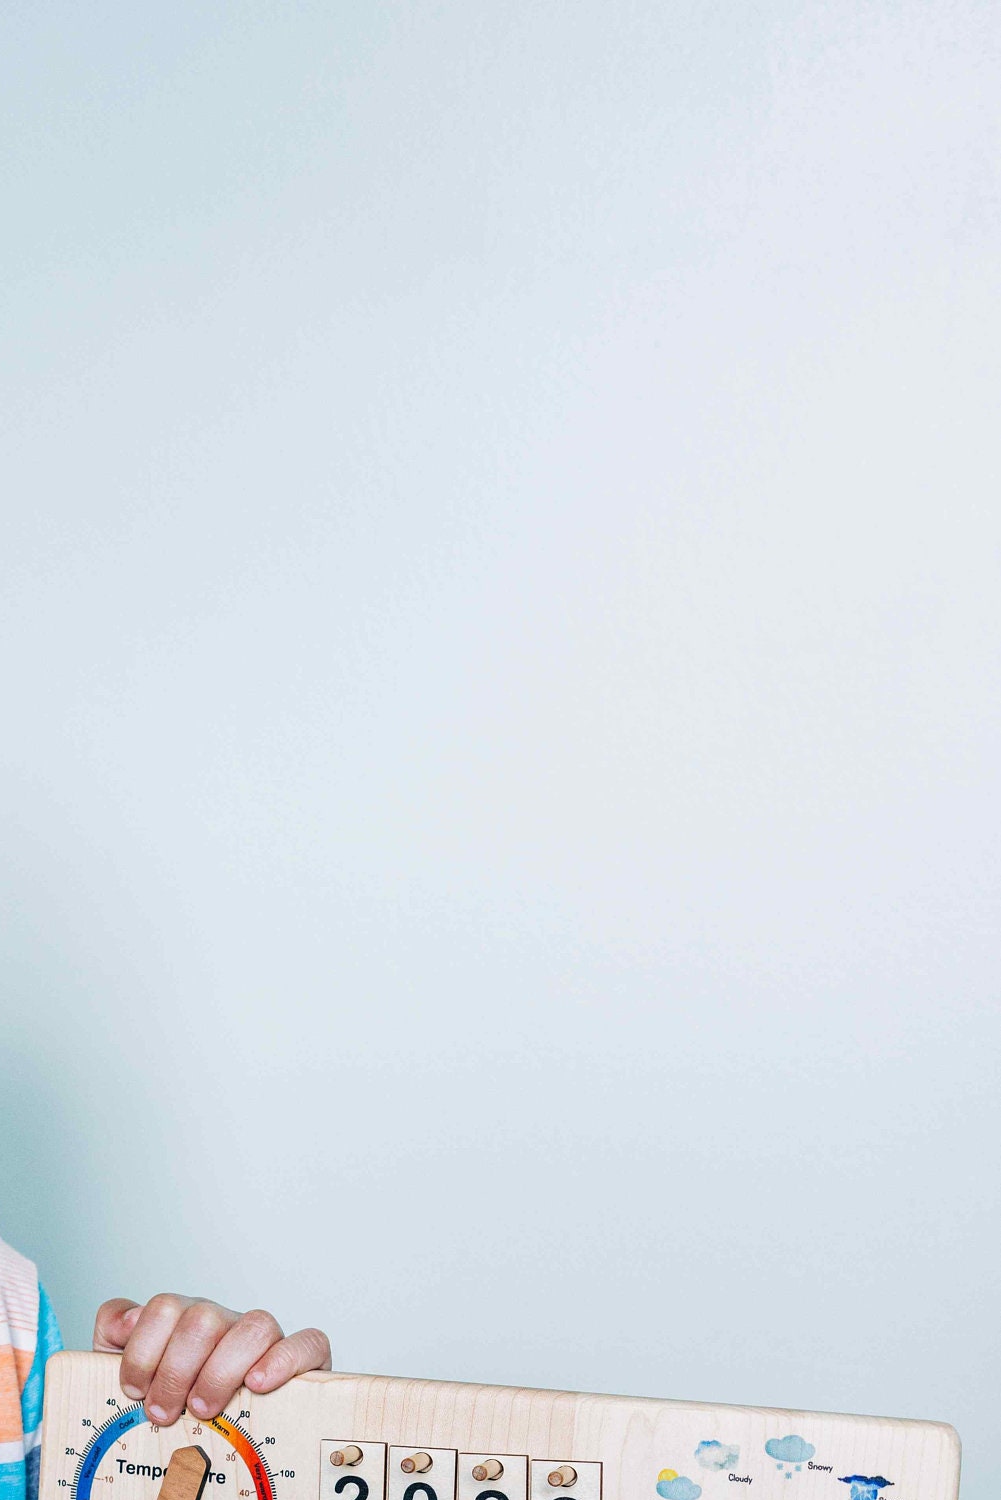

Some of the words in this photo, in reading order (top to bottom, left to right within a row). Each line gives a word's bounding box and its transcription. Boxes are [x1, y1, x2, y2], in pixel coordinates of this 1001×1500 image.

[240, 1410, 250, 1418] 80
[82, 1419, 92, 1427] 30
[119, 1417, 135, 1429] Cold
[192, 1427, 202, 1435] 20
[211, 1418, 230, 1437] Warm
[265, 1437, 276, 1445] 90
[226, 1453, 236, 1462] 30
[807, 1461, 833, 1473] Snowy
[280, 1470, 295, 1478] 100
[728, 1473, 753, 1485] Cloudy
[239, 1489, 250, 1497] 40
